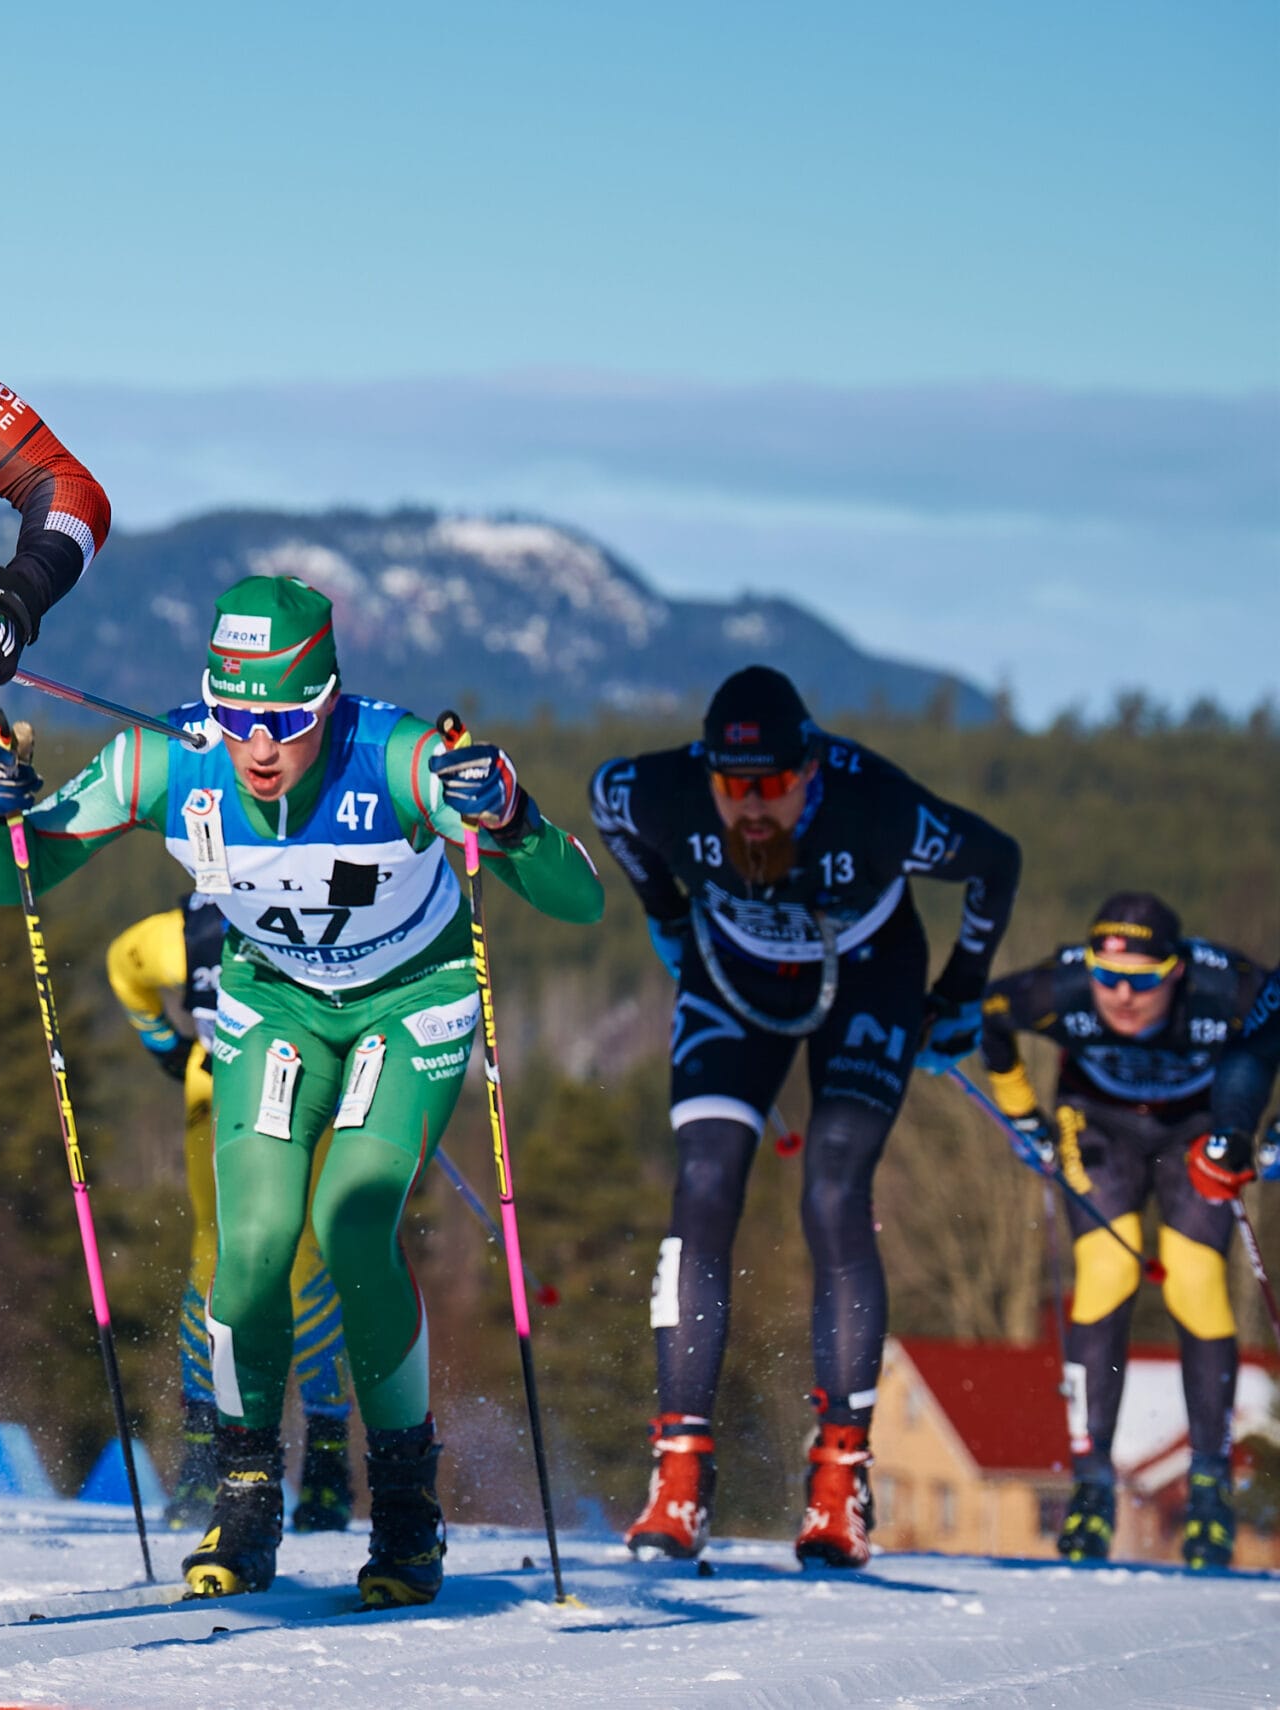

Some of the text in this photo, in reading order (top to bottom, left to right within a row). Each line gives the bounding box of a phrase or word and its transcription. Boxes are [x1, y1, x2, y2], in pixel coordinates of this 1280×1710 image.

[227, 631, 267, 643] FRONT
[336, 791, 378, 831] 47
[688, 832, 723, 867] 13
[902, 803, 950, 872] 157
[820, 851, 855, 887] 13
[26, 914, 49, 975] LEKI
[256, 906, 352, 946] 47
[411, 1046, 465, 1072] Rustad
